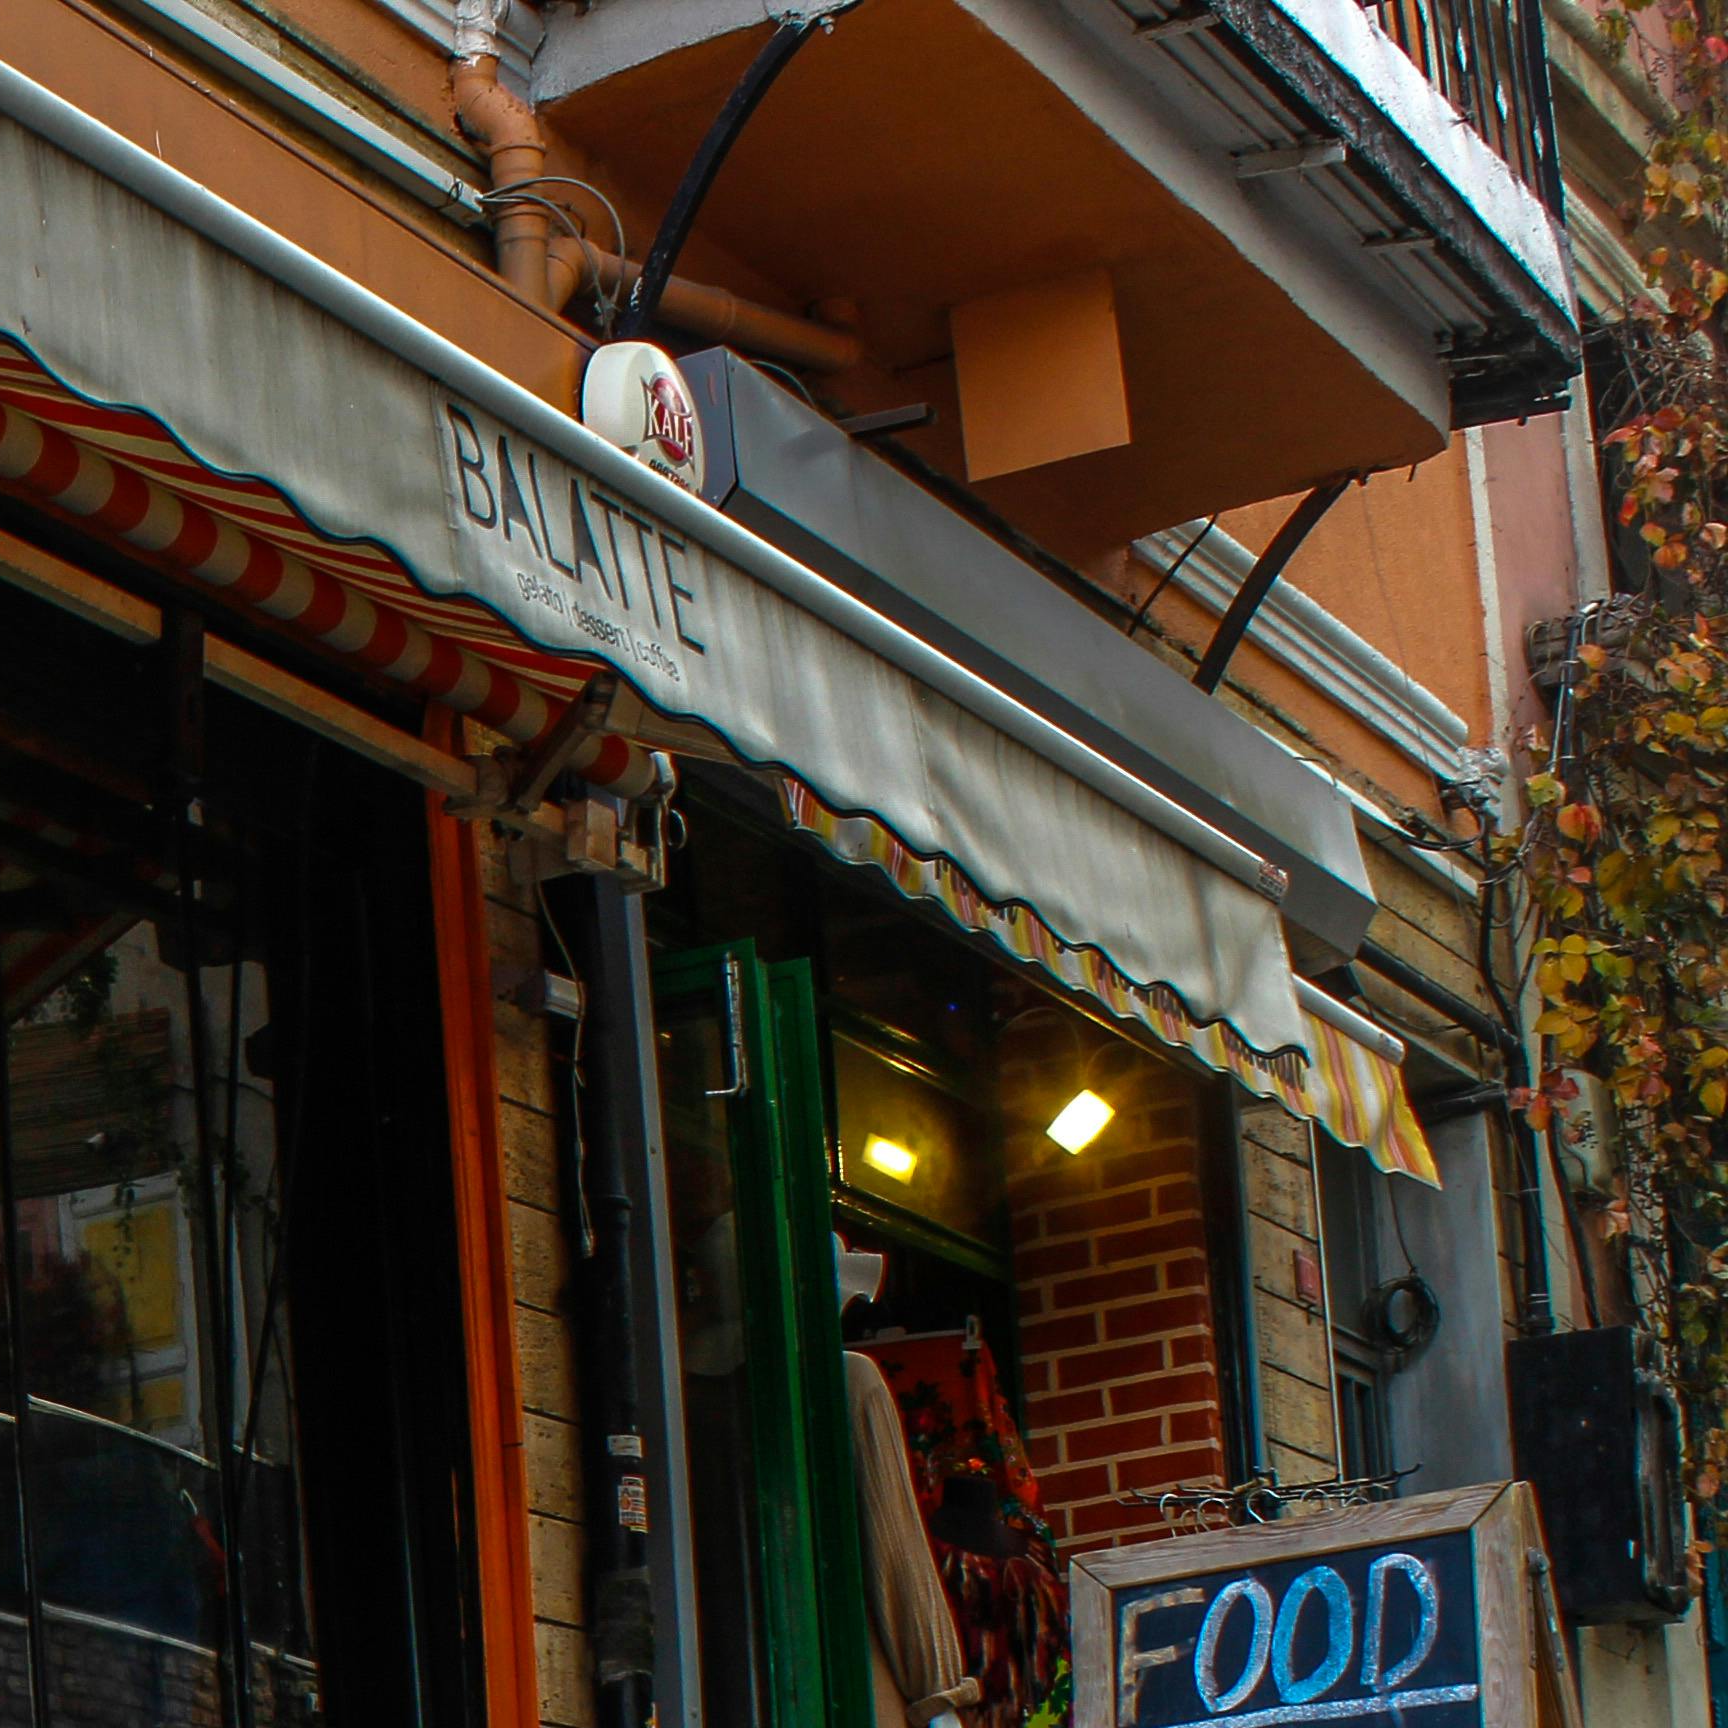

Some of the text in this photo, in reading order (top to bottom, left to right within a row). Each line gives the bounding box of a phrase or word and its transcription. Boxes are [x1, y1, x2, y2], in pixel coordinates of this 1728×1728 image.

[647, 387, 693, 460] KALE
[446, 402, 705, 656] BALATTE
[516, 572, 564, 614] gelato
[572, 601, 630, 652] dessert
[1119, 1552, 1439, 1726] FOOD
